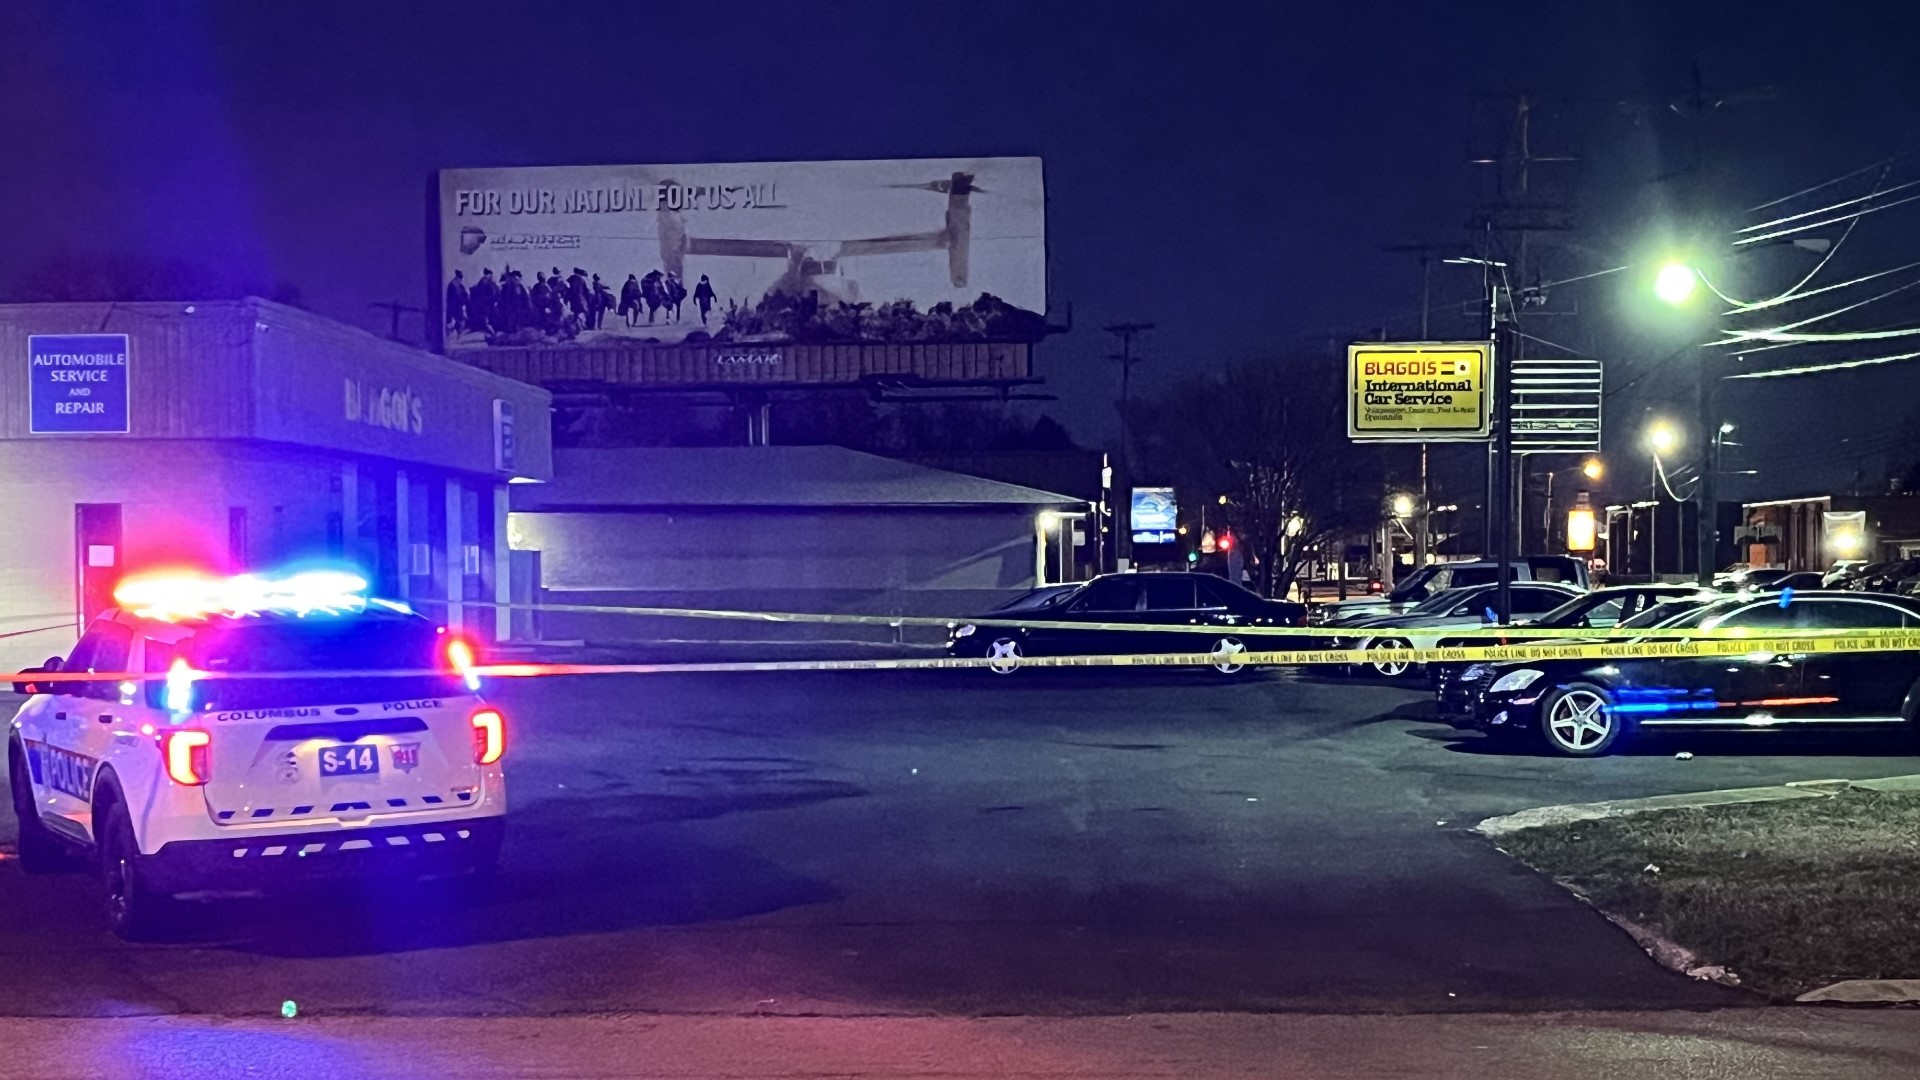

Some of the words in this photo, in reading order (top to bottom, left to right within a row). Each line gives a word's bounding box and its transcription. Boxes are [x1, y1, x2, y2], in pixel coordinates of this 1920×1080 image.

[455, 189, 501, 216] FOR
[509, 188, 555, 215] OUR
[655, 184, 700, 212] FOR
[707, 184, 736, 210] US
[34, 354, 125, 366] AUTOMOBILE
[51, 370, 108, 382] SERVICE
[1365, 380, 1473, 391] International
[68, 388, 91, 397] AND
[1365, 393, 1391, 405] Car
[1395, 391, 1453, 405] Service
[56, 402, 105, 414] REPAIR
[1776, 641, 1789, 651] NOT
[1792, 640, 1816, 651] CROSS
[217, 708, 321, 722] COLUMBUS
[382, 700, 444, 712] POLICE
[323, 748, 372, 773] S-14
[49, 749, 91, 800] POLICE
